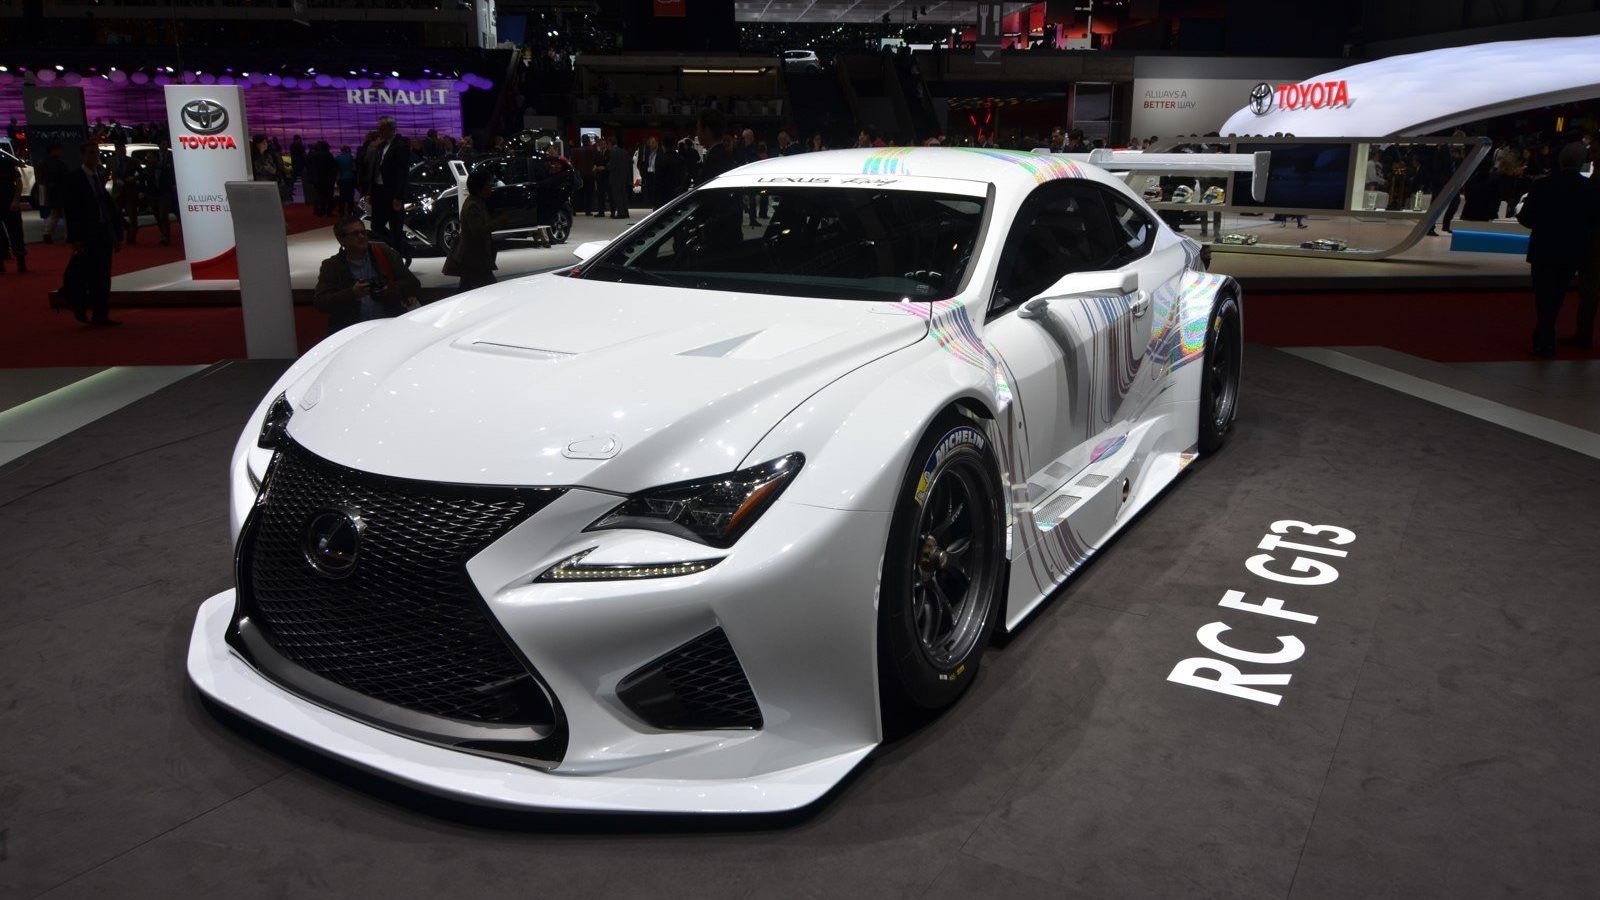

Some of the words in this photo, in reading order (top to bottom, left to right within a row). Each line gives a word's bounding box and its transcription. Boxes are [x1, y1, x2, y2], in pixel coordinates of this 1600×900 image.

[346, 88, 448, 105] RENAULT
[1145, 90, 1179, 98] ALWAYS
[1181, 90, 1187, 98] A
[1277, 80, 1348, 109] TOYOTA
[1143, 101, 1176, 109] BETTER
[1177, 101, 1197, 109] WAY
[179, 136, 236, 149] TOYOTA
[187, 194, 224, 202] ALWAYS
[188, 204, 222, 212] BETTER
[935, 430, 985, 467] MICHELIN
[1245, 519, 1357, 586] GT3
[1218, 589, 1319, 625] F
[1166, 621, 1306, 706] RC
